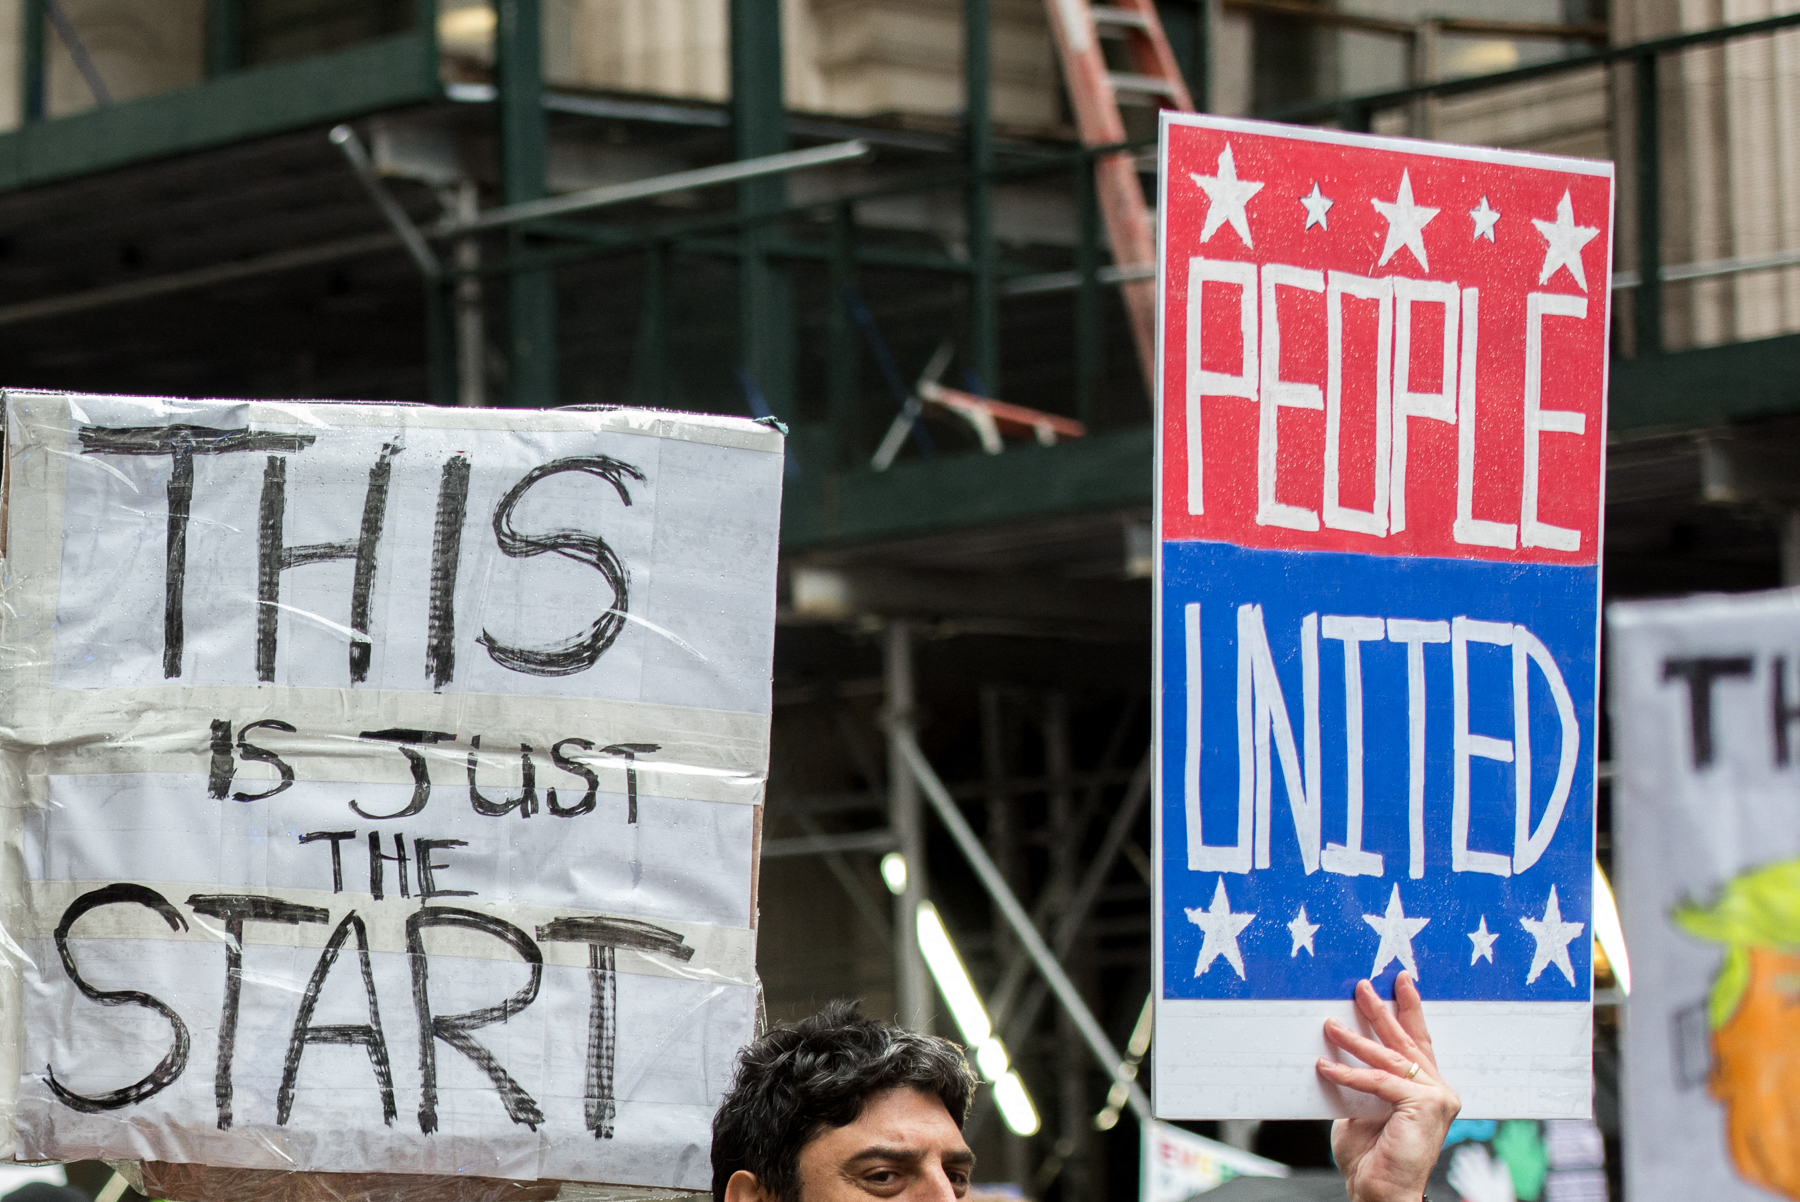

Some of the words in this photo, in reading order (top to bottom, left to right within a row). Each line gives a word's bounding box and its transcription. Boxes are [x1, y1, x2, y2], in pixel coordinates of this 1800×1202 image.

[1185, 255, 1589, 552] PEOPLE
[77, 423, 647, 690] THIS
[208, 718, 297, 802] IS
[349, 728, 663, 825] JUST
[300, 830, 481, 902] THE
[1184, 602, 1581, 880] UNITED
[42, 882, 695, 1139] START
